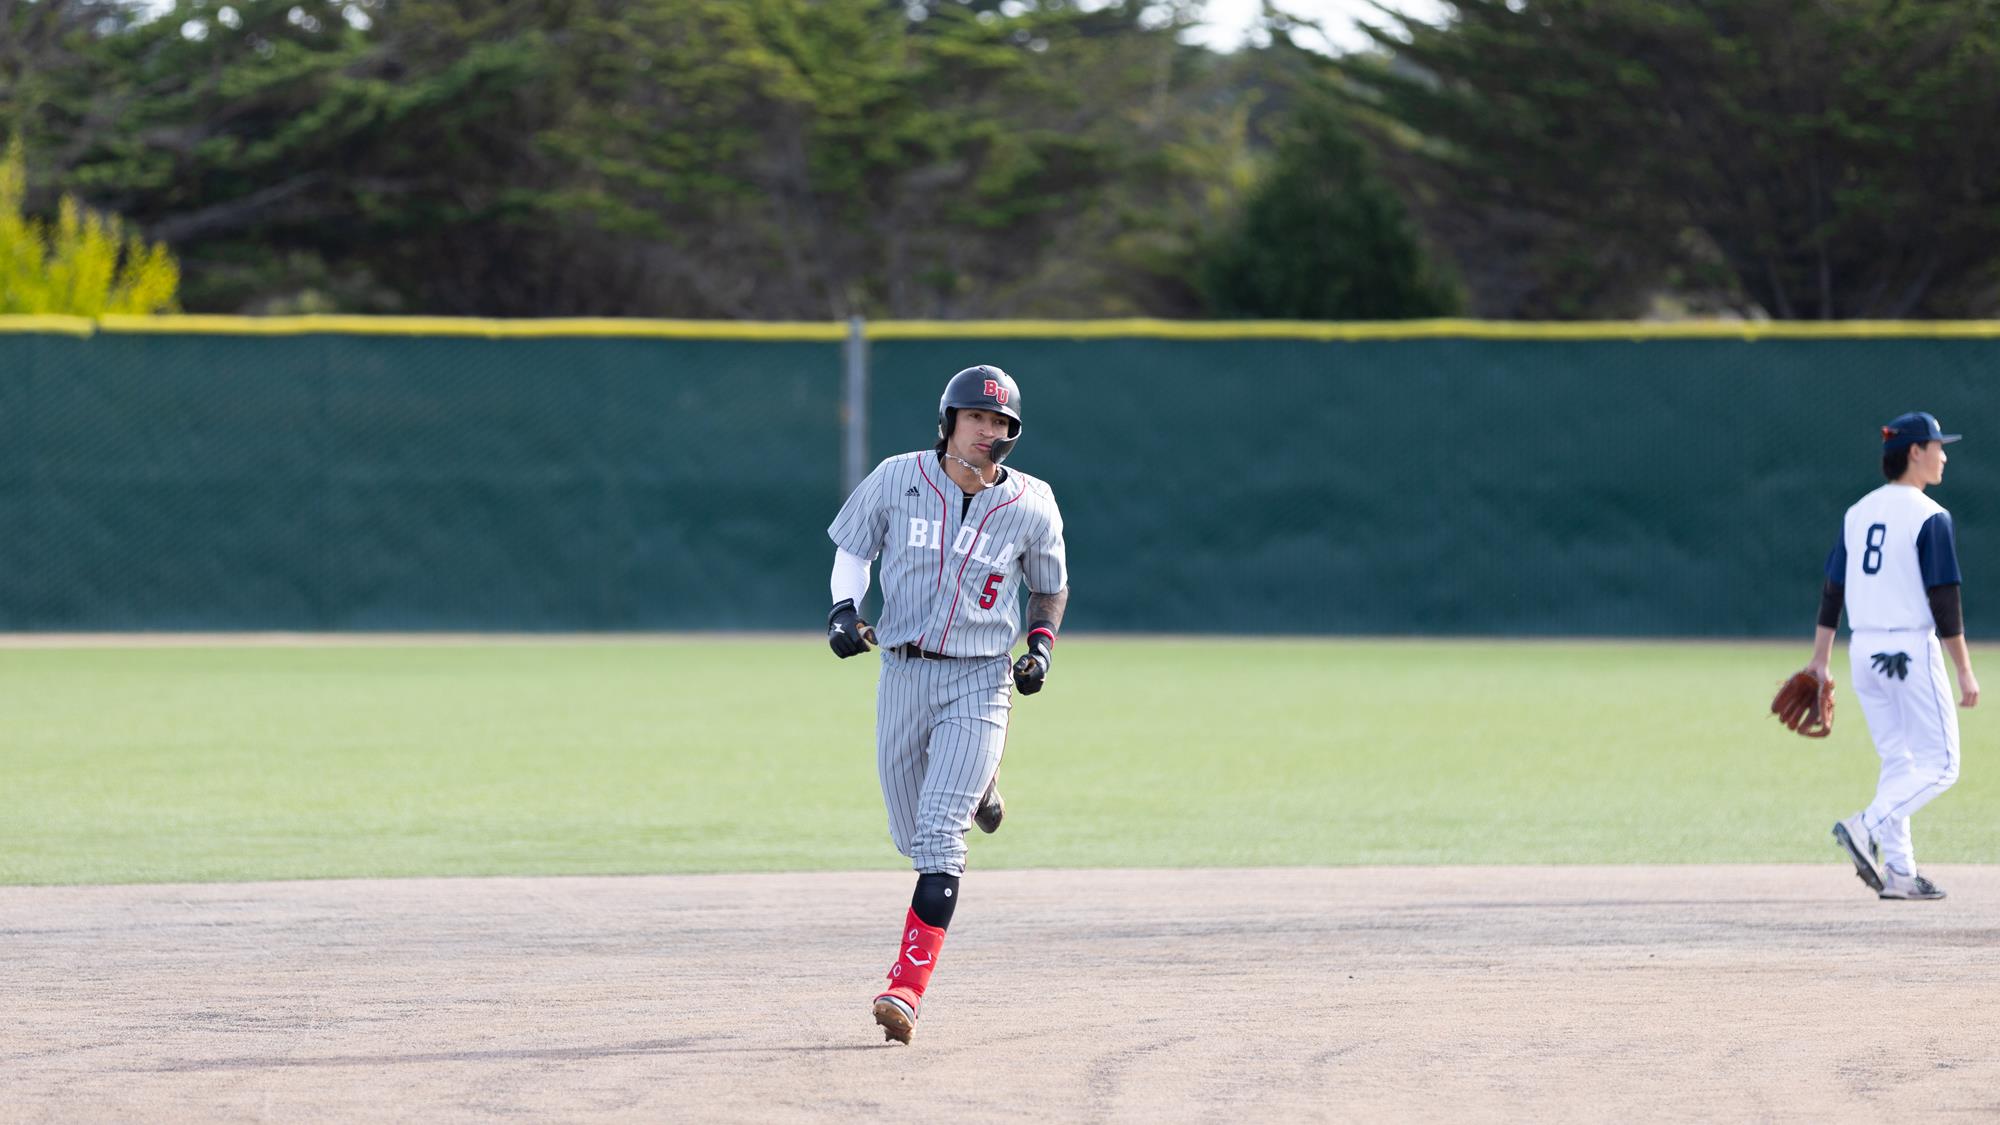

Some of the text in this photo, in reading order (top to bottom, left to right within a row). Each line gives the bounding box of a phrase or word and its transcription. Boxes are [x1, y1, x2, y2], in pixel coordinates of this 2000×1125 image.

[984, 380, 1009, 405] BU
[907, 517, 1014, 569] BIOLA
[1862, 523, 1886, 575] 8
[979, 573, 1004, 610] 5
